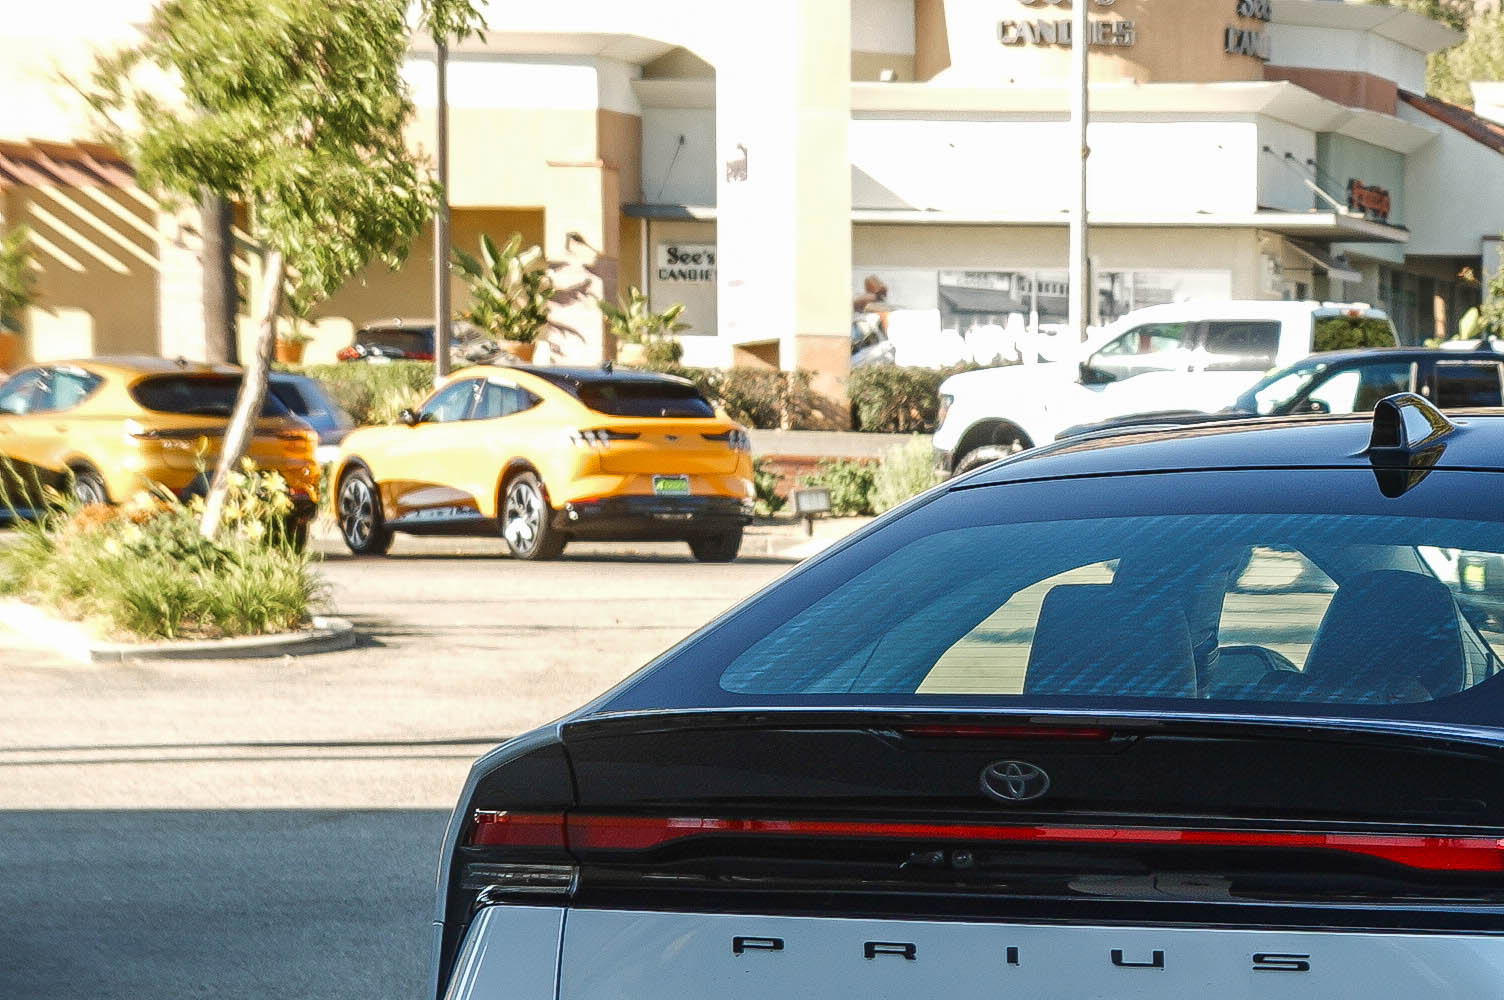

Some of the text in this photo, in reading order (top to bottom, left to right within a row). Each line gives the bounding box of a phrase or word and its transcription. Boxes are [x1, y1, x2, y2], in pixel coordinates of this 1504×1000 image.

[666, 247, 715, 265] See's
[658, 268, 714, 281] CANDIE
[733, 936, 1310, 972] PRIUS
